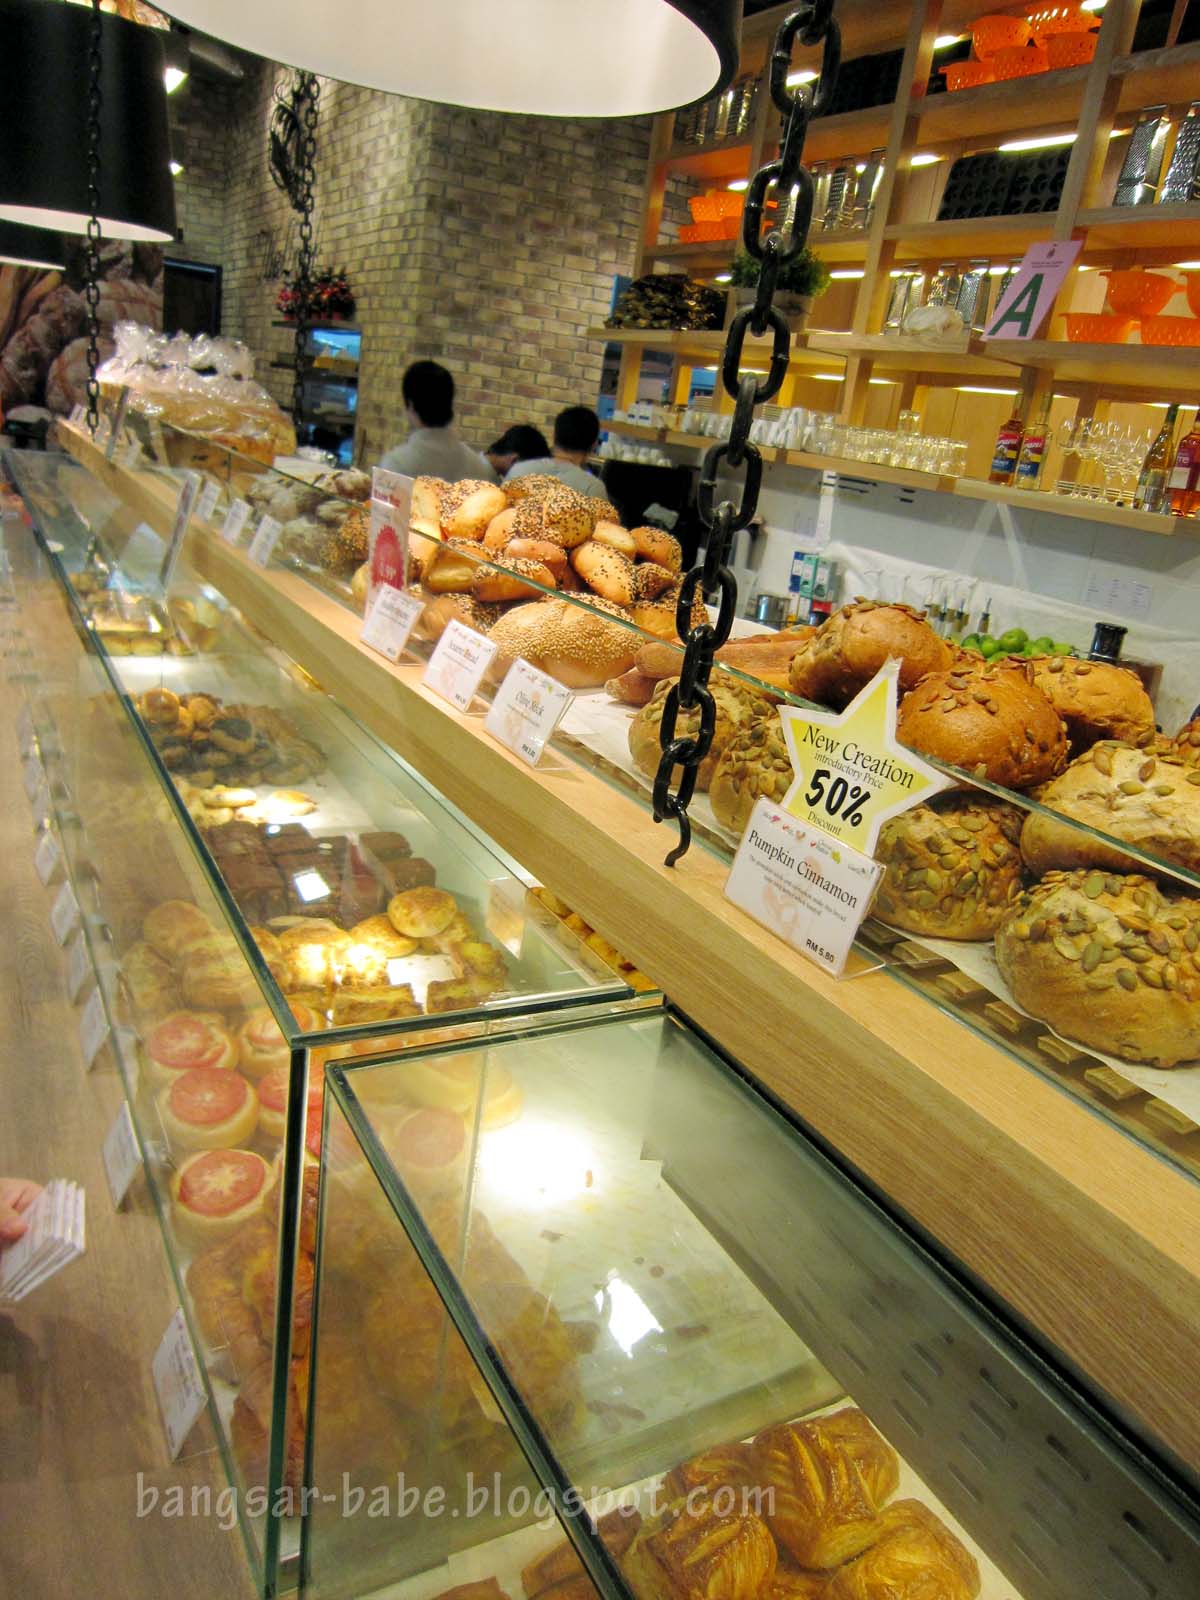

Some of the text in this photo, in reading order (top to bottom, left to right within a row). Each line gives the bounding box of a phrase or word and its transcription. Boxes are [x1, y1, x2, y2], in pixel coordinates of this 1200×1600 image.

[986, 273, 1045, 337] A
[802, 724, 914, 789] New Creation
[863, 772, 885, 790] Price
[805, 768, 871, 827] 50%
[807, 811, 842, 836] Discount
[748, 829, 795, 870] Pumpkin
[797, 860, 858, 909] Cinnamon
[806, 938, 835, 963] RM 5.80
